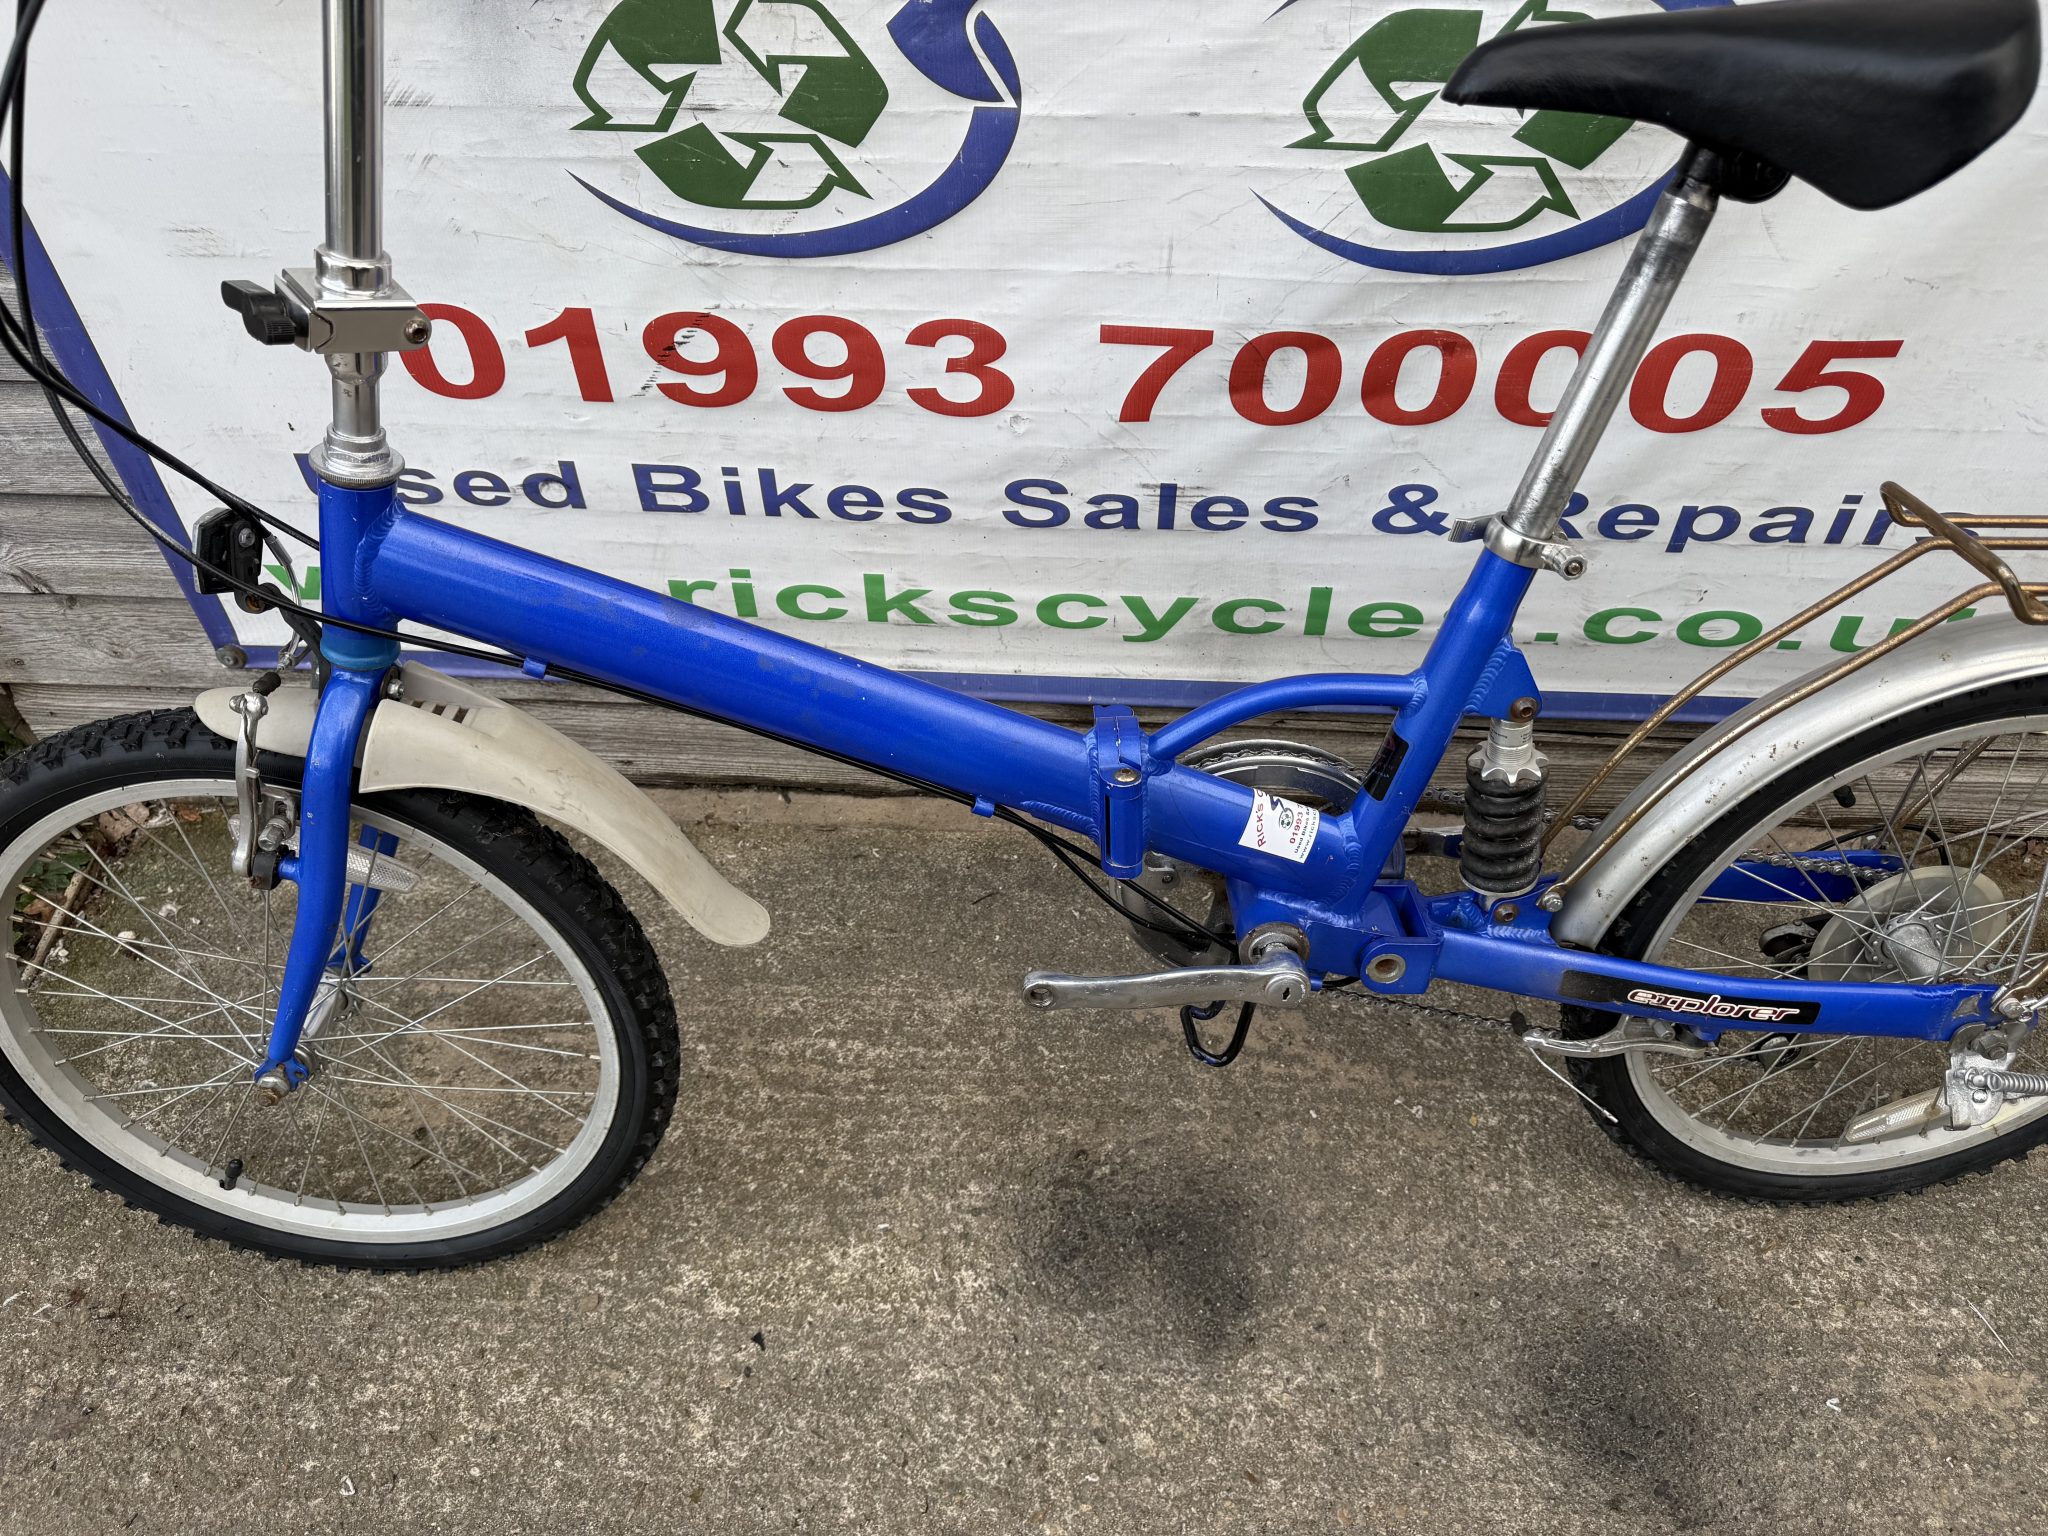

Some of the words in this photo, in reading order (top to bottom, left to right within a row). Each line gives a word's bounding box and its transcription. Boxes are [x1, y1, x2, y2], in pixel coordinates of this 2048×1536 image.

[399, 303, 1015, 418] 01993
[1099, 324, 1904, 435] 700005
[631, 463, 952, 525] Bikes
[1003, 479, 1319, 533] Sales
[1371, 484, 1450, 536] &
[1290, 811, 1304, 844] 01993
[1627, 989, 1801, 1022] explorer
